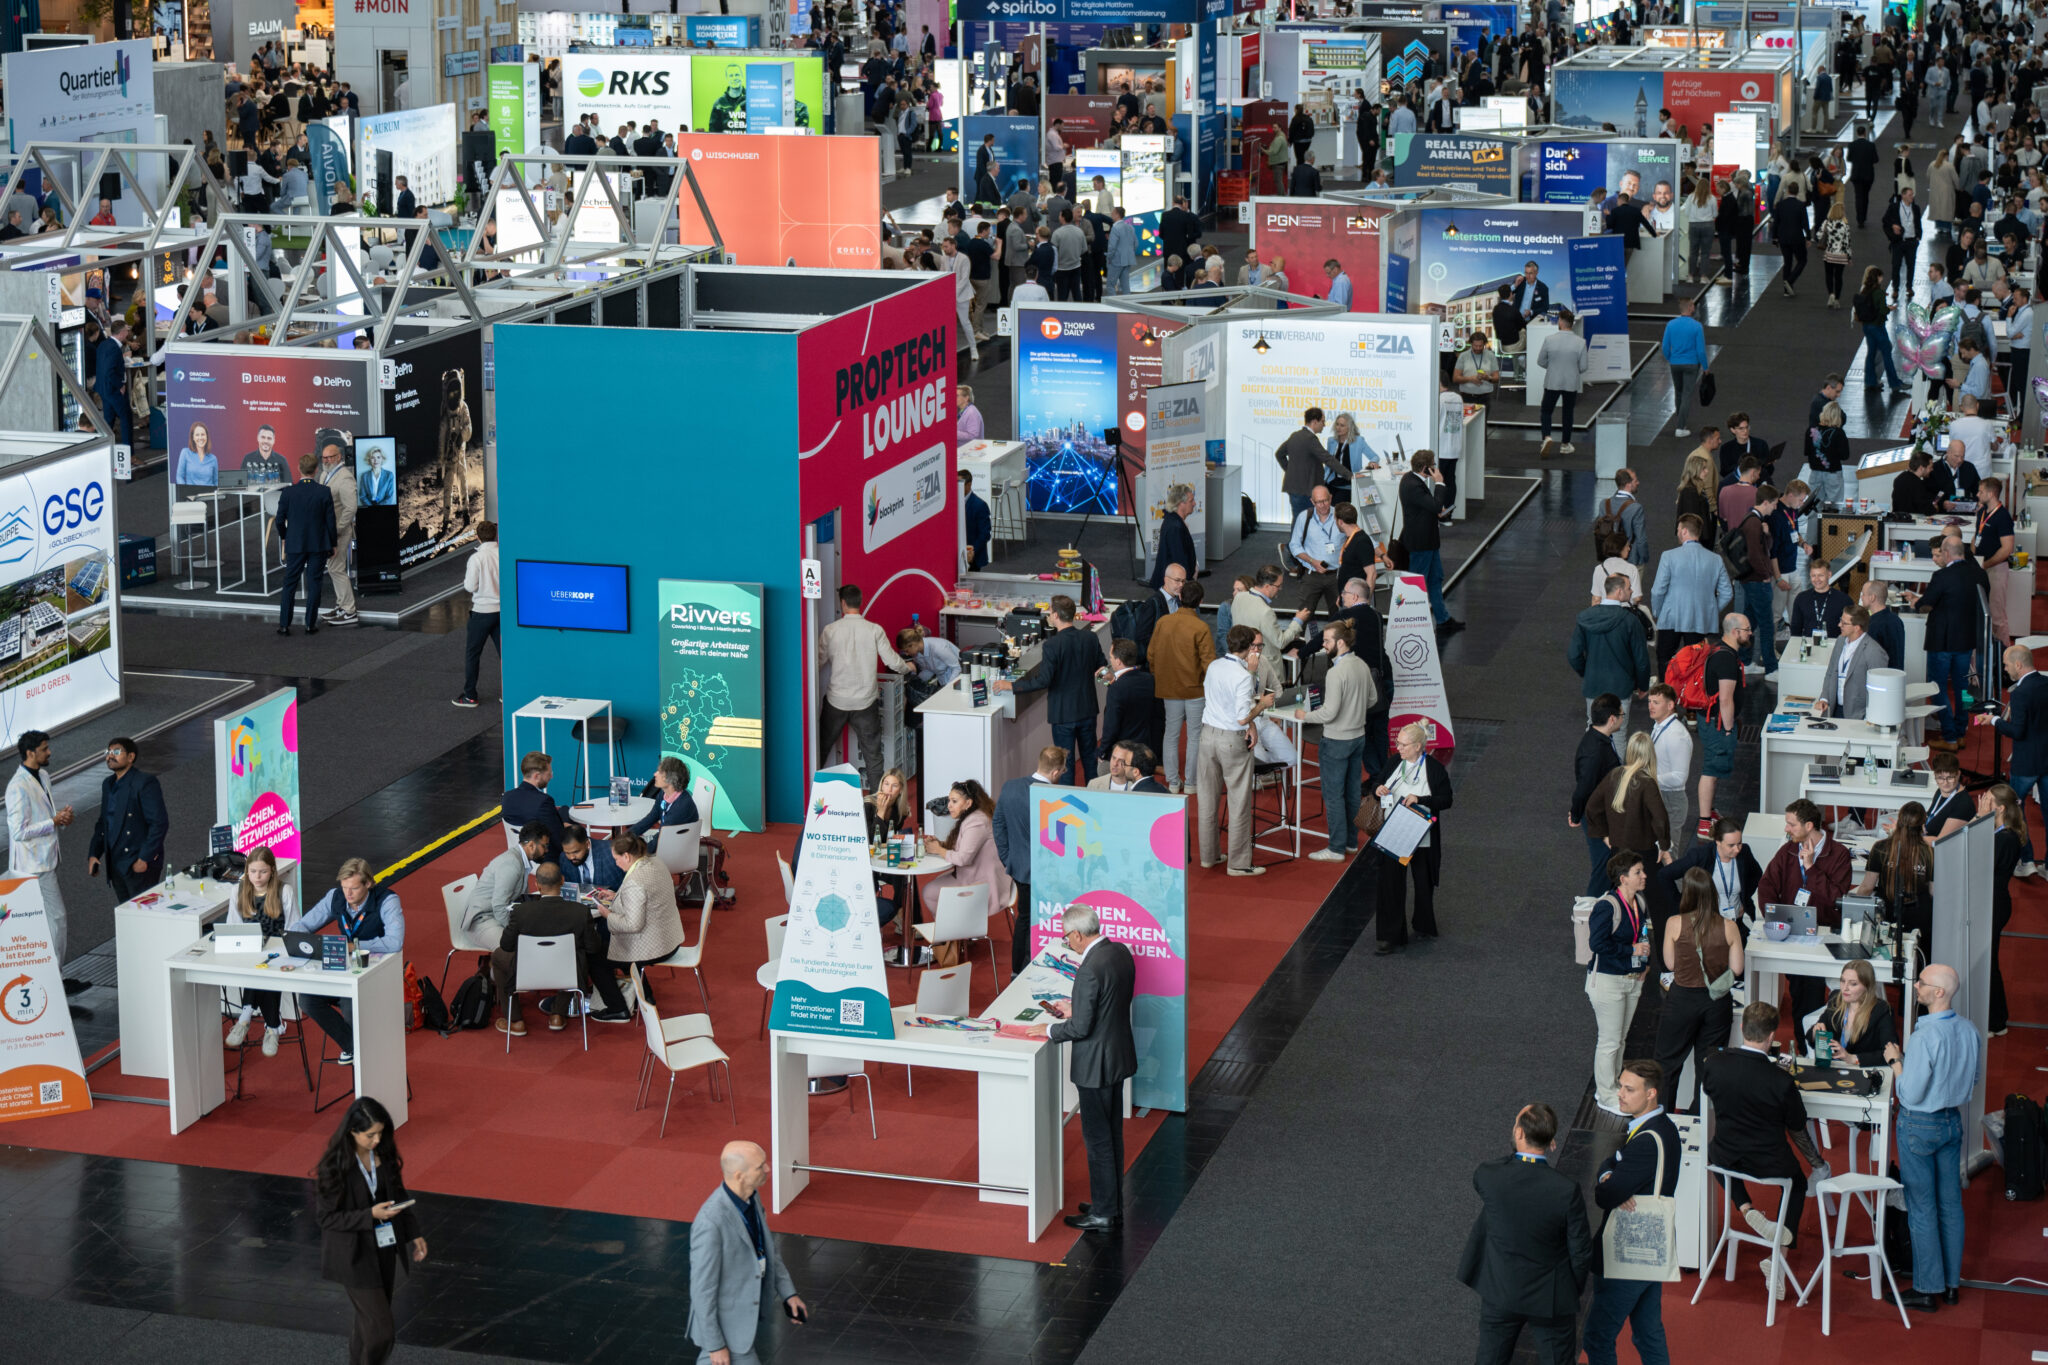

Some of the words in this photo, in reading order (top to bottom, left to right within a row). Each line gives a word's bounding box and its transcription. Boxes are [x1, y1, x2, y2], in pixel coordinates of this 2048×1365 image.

[354, 0, 409, 13] #MOIN
[1002, 0, 1056, 16] spiri.bo
[1081, 1, 1104, 10] digitale
[249, 20, 282, 36] BAUM
[60, 66, 118, 95] Quartier
[608, 70, 671, 96] RKS
[1671, 79, 1702, 89] Aufzüge
[1671, 88, 1684, 97] auf
[1684, 88, 1721, 98] höchstem
[1671, 97, 1690, 106] Level
[728, 111, 746, 119] WIR
[374, 120, 400, 135] AURUM
[1425, 139, 1457, 150] REAL
[1459, 140, 1504, 151] ESTATE
[705, 151, 760, 160] WISCHHUSEN
[1429, 150, 1471, 160] ARENA
[1638, 156, 1670, 164] SERVICE
[1420, 164, 1435, 172] Jetzt
[1436, 164, 1471, 173] registrieren
[1545, 160, 1567, 171] sich
[1451, 172, 1485, 180] Community
[1267, 214, 1299, 227] PGN
[1503, 233, 1521, 243] neu
[1523, 234, 1563, 245] gedacht
[726, 256, 733, 265] B
[50, 277, 57, 286] C
[51, 301, 58, 310] C
[1000, 314, 1008, 322] A
[1063, 322, 1095, 330] THOMAS
[1063, 328, 1085, 337] DAILY
[1241, 329, 1325, 342] SPITZENVERBAND
[1442, 329, 1450, 338] A
[1375, 334, 1414, 354] ZIA
[1198, 340, 1215, 378] ZIA
[383, 365, 390, 374] B
[836, 325, 946, 417] PROPTECH
[1320, 367, 1396, 379] STADTENTWICKLUNG
[254, 374, 287, 383] DELPARK
[324, 376, 352, 387] DelPro
[1320, 376, 1383, 388] INNOVATION
[1241, 384, 1320, 396] DIGITALISIERUNG
[1320, 387, 1407, 400] ZUKUNFTSSTUDIE
[1172, 397, 1199, 417] ZIA
[1248, 398, 1279, 408] EUROPA
[1279, 396, 1338, 411] TRUSTED
[1339, 399, 1398, 413] ADVISOR
[863, 376, 946, 460] LOUNGE
[1377, 420, 1413, 431] POLITIK
[117, 451, 125, 462] B
[924, 470, 941, 500] ZIA
[879, 496, 904, 520] blackprint
[51, 532, 83, 549] GOLDBECK
[805, 567, 815, 580] A
[551, 590, 595, 600] UEBERKOPF
[670, 604, 752, 625] Rivvers
[671, 623, 697, 631] Coworking
[671, 638, 709, 649] Großartige
[710, 640, 750, 651] Arbeitstage
[679, 648, 699, 656] direkt
[708, 649, 729, 658] deiner
[730, 650, 749, 658] Nähe
[26, 683, 46, 700] BUILD
[47, 673, 72, 690] GREEN.
[827, 809, 860, 818] blackprint
[232, 803, 276, 836] NASCHEN.
[233, 810, 294, 851] NETZWERKEN.
[267, 826, 294, 848] BAUEN.
[806, 832, 821, 841] WO
[822, 833, 846, 843] STEHT
[847, 835, 866, 844] IHR?
[815, 853, 858, 862] Dimensionen
[11, 909, 43, 919] blackprint
[11, 935, 27, 943] Wie
[6, 952, 16, 960] ist
[17, 950, 36, 959] Euer
[801, 957, 830, 967] fundierte
[830, 961, 856, 970] Analyse
[804, 966, 859, 977] Zukunftsfähigkeit.
[20, 988, 31, 1008] 3
[791, 995, 807, 1003] Mehr
[17, 1007, 34, 1016] min
[790, 1011, 809, 1019] findet
[818, 1013, 832, 1021] hier:
[25, 1033, 44, 1042] Quick
[45, 1030, 65, 1039] Check
[19, 1041, 46, 1049] Minuten.
[13, 1092, 33, 1100] Check
[9, 1099, 33, 1108] starten.
